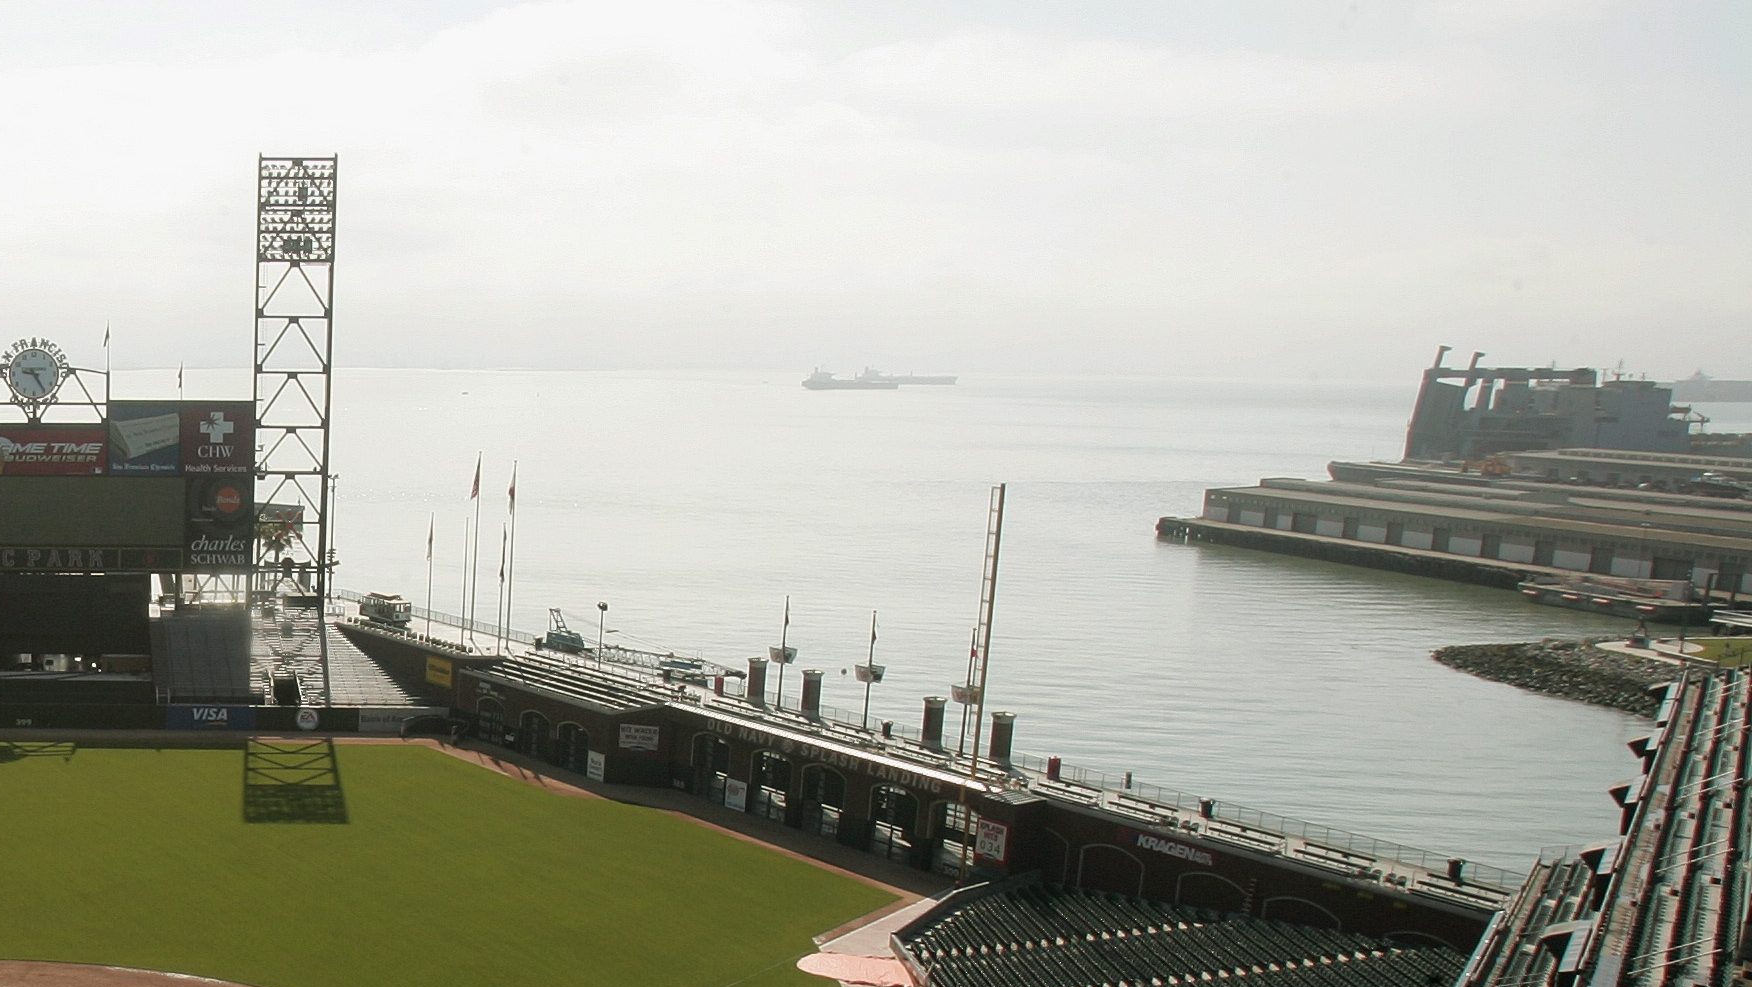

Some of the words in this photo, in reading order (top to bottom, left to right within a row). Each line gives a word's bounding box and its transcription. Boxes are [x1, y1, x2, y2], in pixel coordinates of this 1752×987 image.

[11, 337, 70, 378] FRANCISCO
[50, 442, 103, 454] TIME
[197, 445, 235, 458] CHW
[4, 454, 97, 463] BUDWEISER
[185, 464, 211, 473] Health
[213, 464, 247, 473] Services
[191, 534, 247, 551] charles
[26, 550, 105, 568] PARK
[190, 553, 245, 565] SCHWAB
[191, 707, 228, 721] VISA
[707, 719, 733, 735] OLD
[739, 727, 776, 747] NAVY
[800, 743, 858, 771] SPLASH
[867, 761, 942, 793] LANDING
[979, 840, 1000, 854] 034
[1137, 834, 1195, 861] KRAGEN
